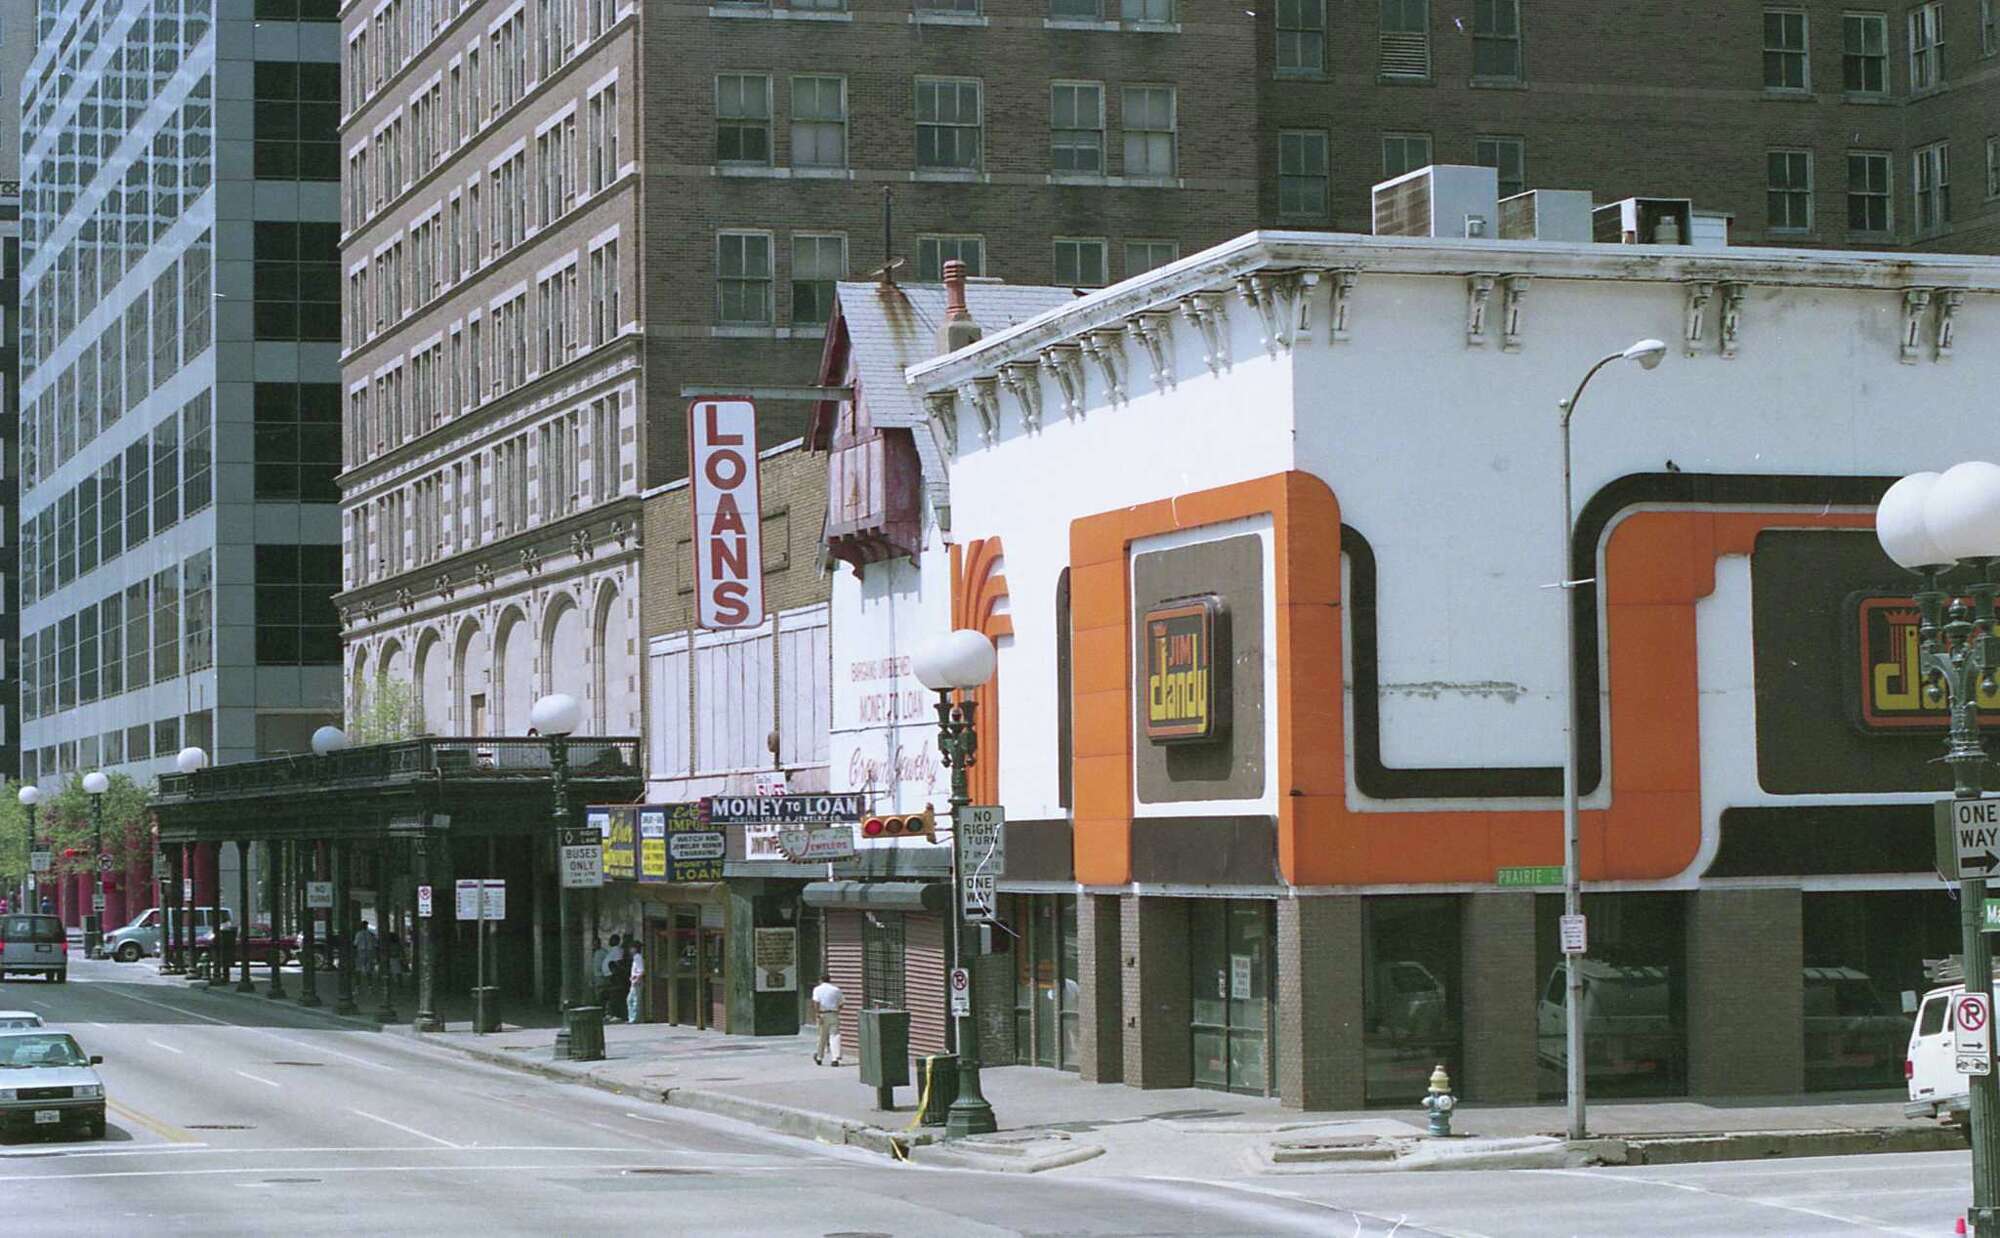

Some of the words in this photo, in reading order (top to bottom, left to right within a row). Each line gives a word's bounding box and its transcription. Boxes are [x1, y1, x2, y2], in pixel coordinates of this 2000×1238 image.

[705, 404, 749, 625] LOANS
[1169, 634, 1193, 666] JIM
[712, 799, 782, 816] MONEY
[786, 802, 800, 812] TO
[805, 798, 858, 814] LOAN
[974, 810, 991, 822] NO
[1960, 804, 1998, 824] ONE
[963, 823, 1000, 835] RIGHT
[968, 836, 998, 845] TURN
[1960, 828, 1998, 848] WAY
[566, 848, 598, 859] BUSES
[570, 860, 593, 871] ONLY
[676, 868, 721, 880] LOAN
[1498, 868, 1542, 885] PRAIRIE
[966, 877, 992, 889] ONE
[966, 890, 992, 903] WAY
